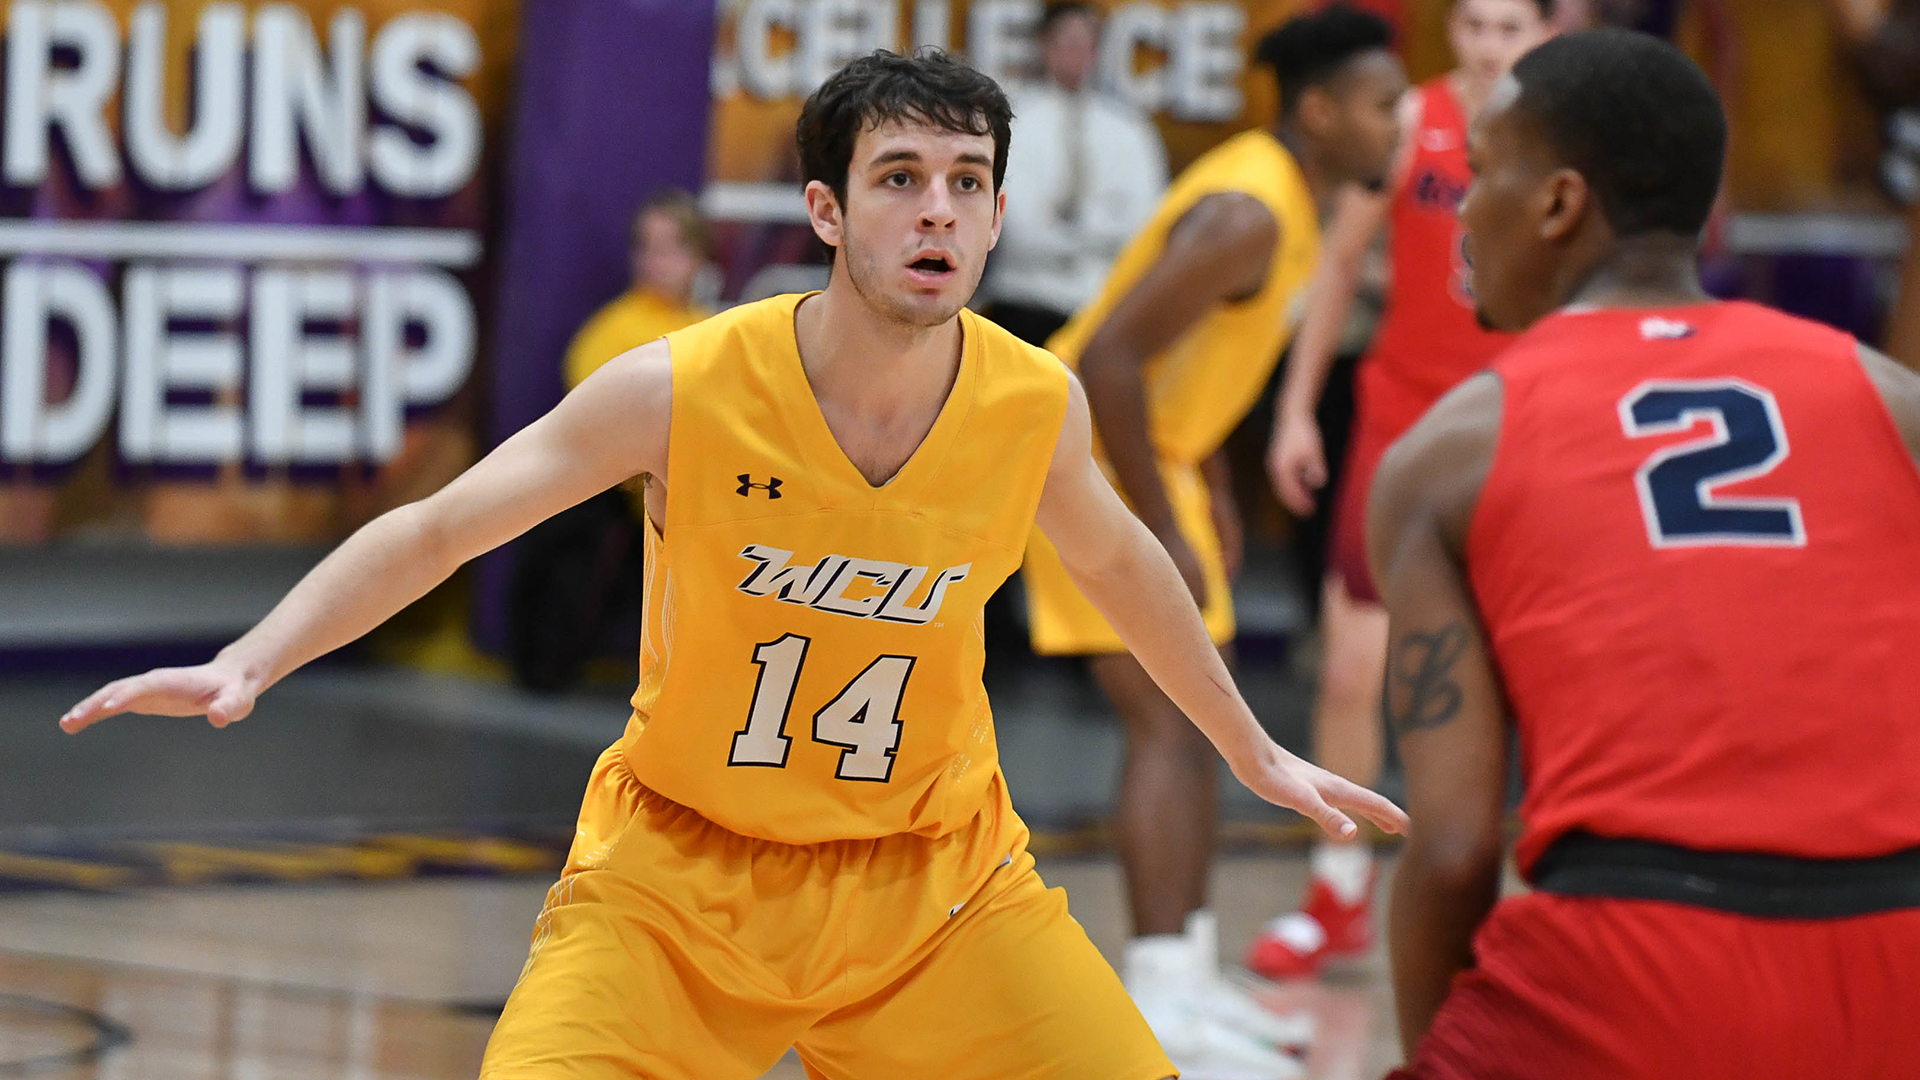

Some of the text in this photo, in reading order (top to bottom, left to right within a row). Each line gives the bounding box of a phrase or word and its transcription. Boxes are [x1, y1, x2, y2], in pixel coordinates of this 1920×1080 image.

[3, 0, 484, 197] RUNS
[1, 262, 478, 464] DEEP
[1616, 377, 1807, 549] 2
[735, 544, 972, 625] WCU
[727, 632, 917, 783] 14
